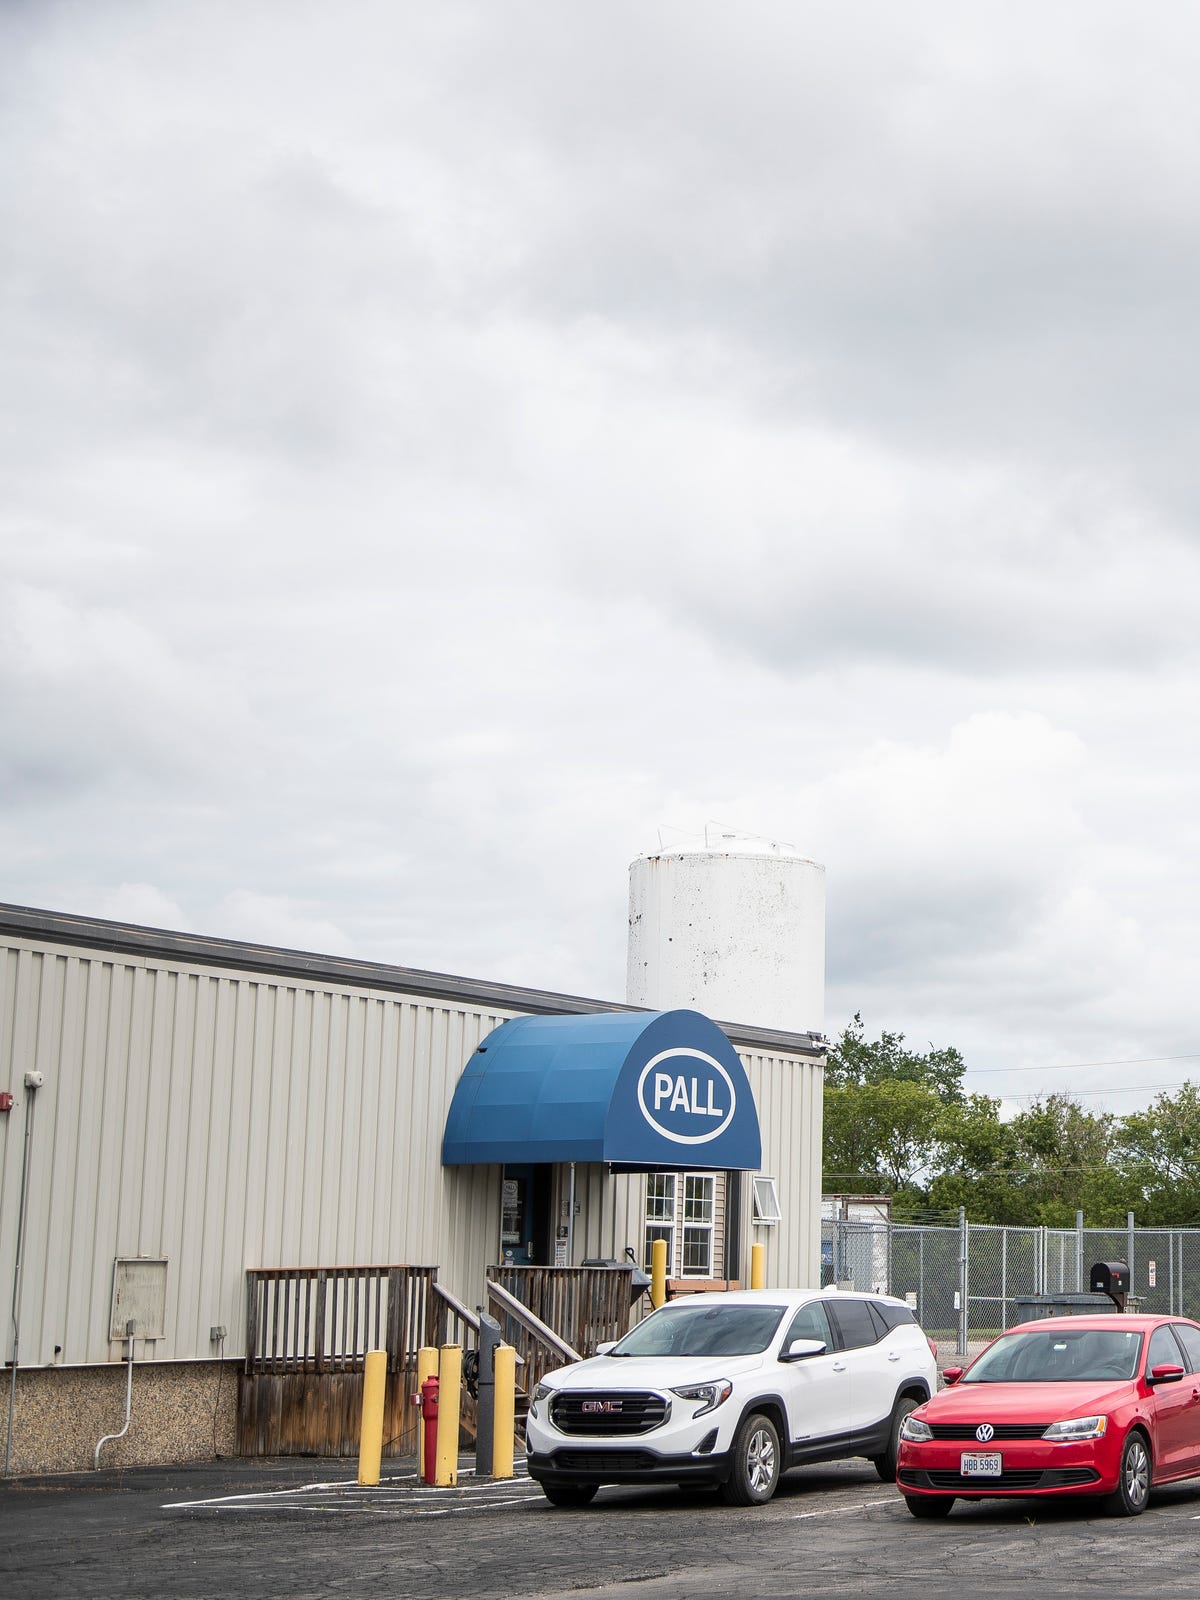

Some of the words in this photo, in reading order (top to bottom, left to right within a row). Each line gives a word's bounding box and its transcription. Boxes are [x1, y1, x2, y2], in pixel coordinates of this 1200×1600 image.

[654, 1072, 723, 1117] PALL
[581, 1401, 623, 1413] GMC
[963, 1459, 978, 1471] HBB
[979, 1459, 999, 1471] 5969
